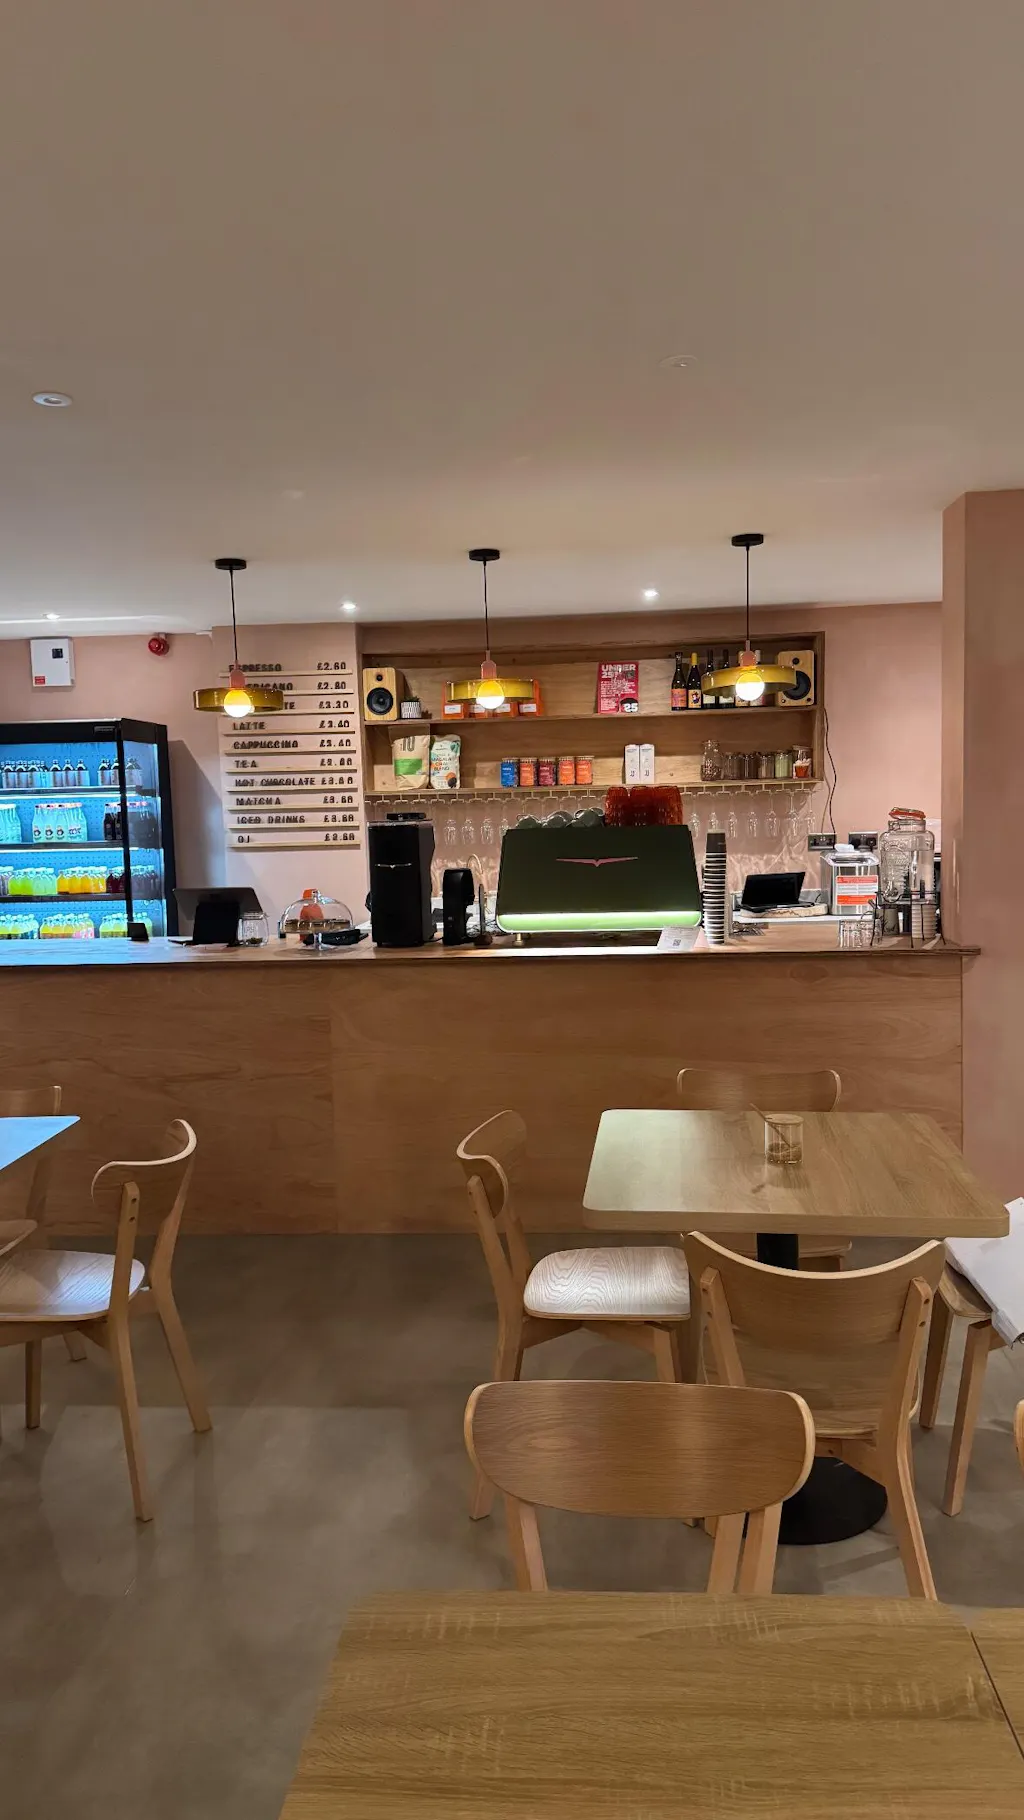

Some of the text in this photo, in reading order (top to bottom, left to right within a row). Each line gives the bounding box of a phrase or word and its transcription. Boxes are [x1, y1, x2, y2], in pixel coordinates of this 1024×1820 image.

[317, 662, 347, 671] £2.60
[245, 682, 293, 691] ERICANO
[623, 703, 638, 712] 25
[233, 722, 266, 730] LATTE
[233, 740, 299, 749] CAPPUCCINO
[235, 760, 258, 768] TEA
[235, 779, 255, 787] HOT
[260, 777, 316, 786] CHOCOLATE
[236, 797, 282, 806] MATCHA
[237, 816, 262, 824] ICED
[267, 815, 306, 823] DRINKS
[237, 835, 250, 843] OJ
